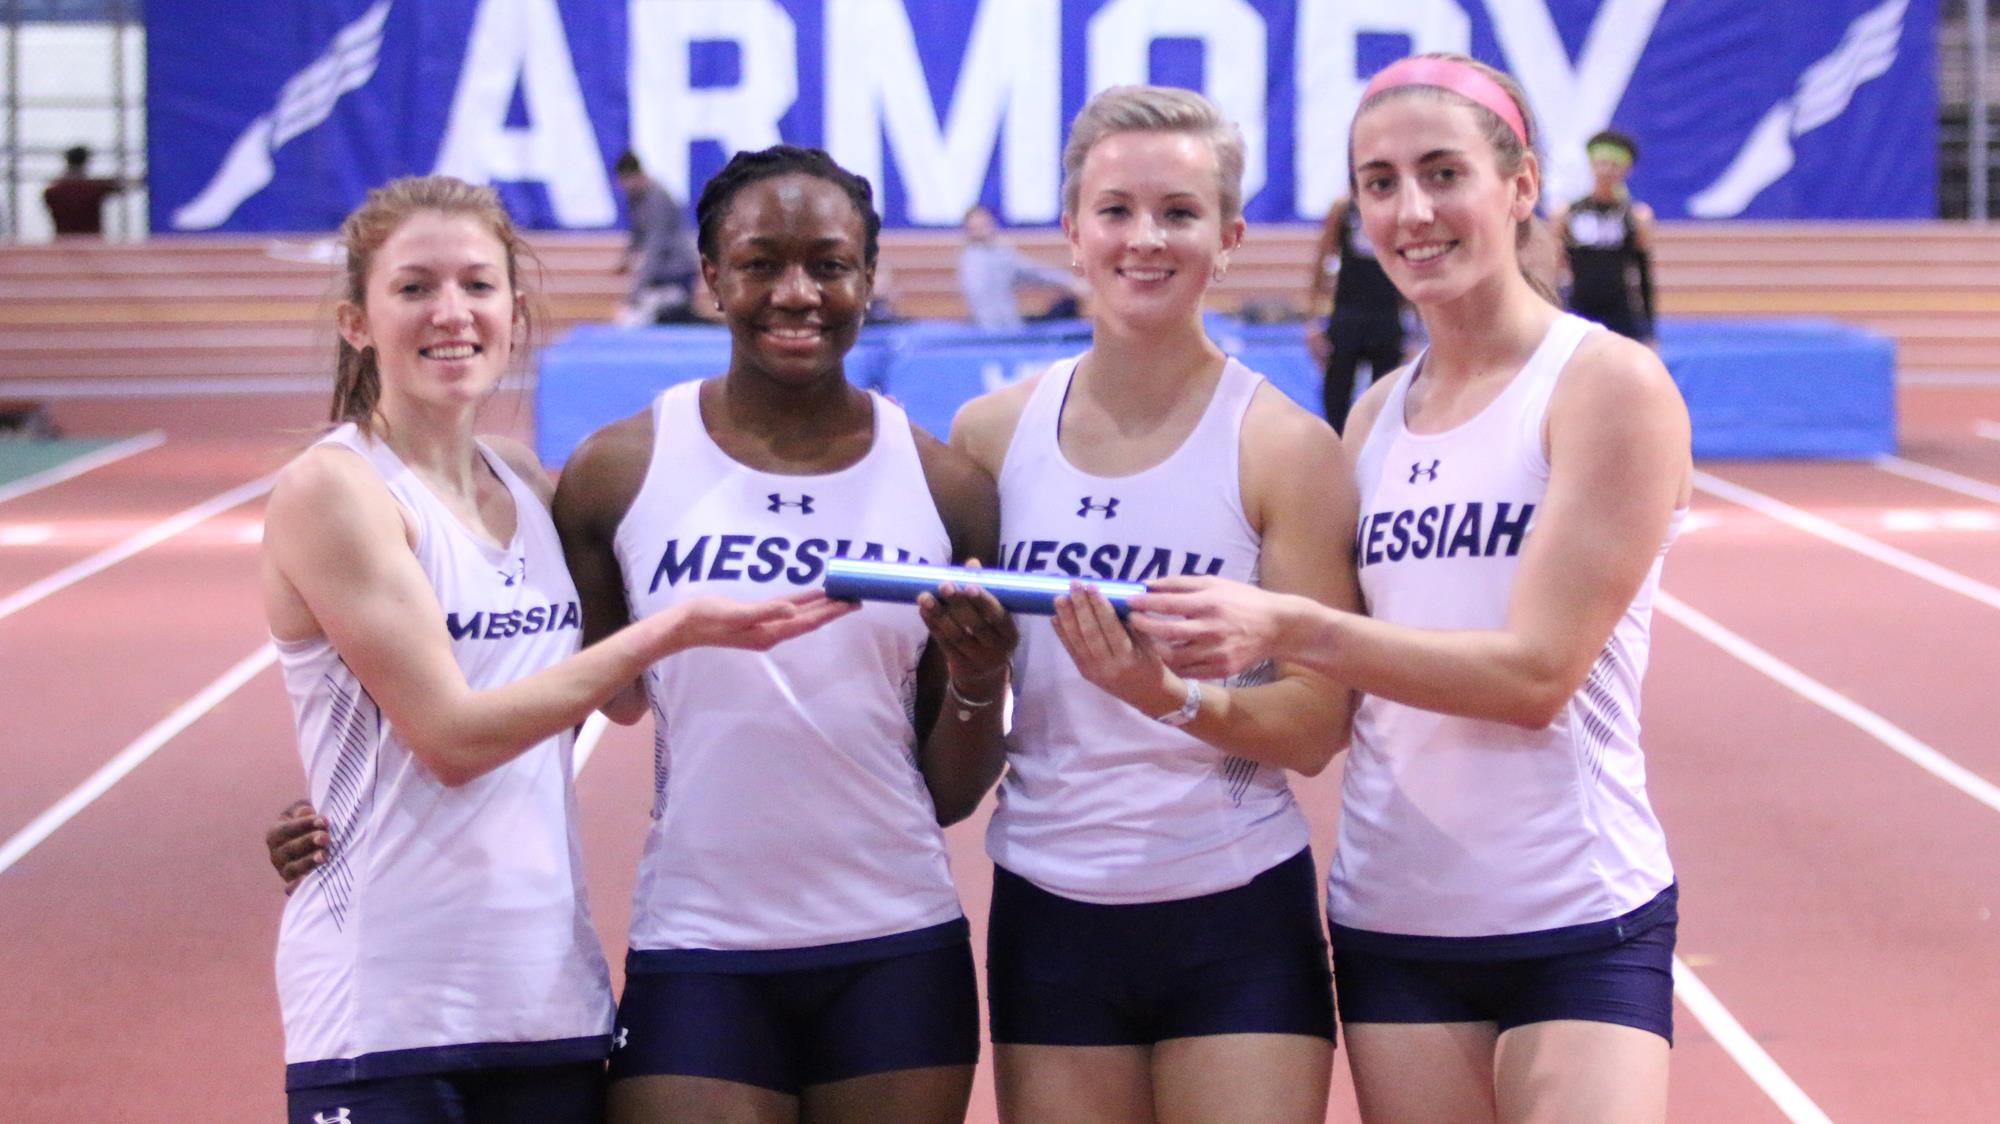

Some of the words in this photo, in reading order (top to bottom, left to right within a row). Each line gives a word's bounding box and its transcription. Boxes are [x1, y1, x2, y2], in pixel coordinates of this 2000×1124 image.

[648, 534, 929, 594] MESS
[1358, 502, 1536, 568] ESSIAH
[446, 601, 584, 641] MESSIA
